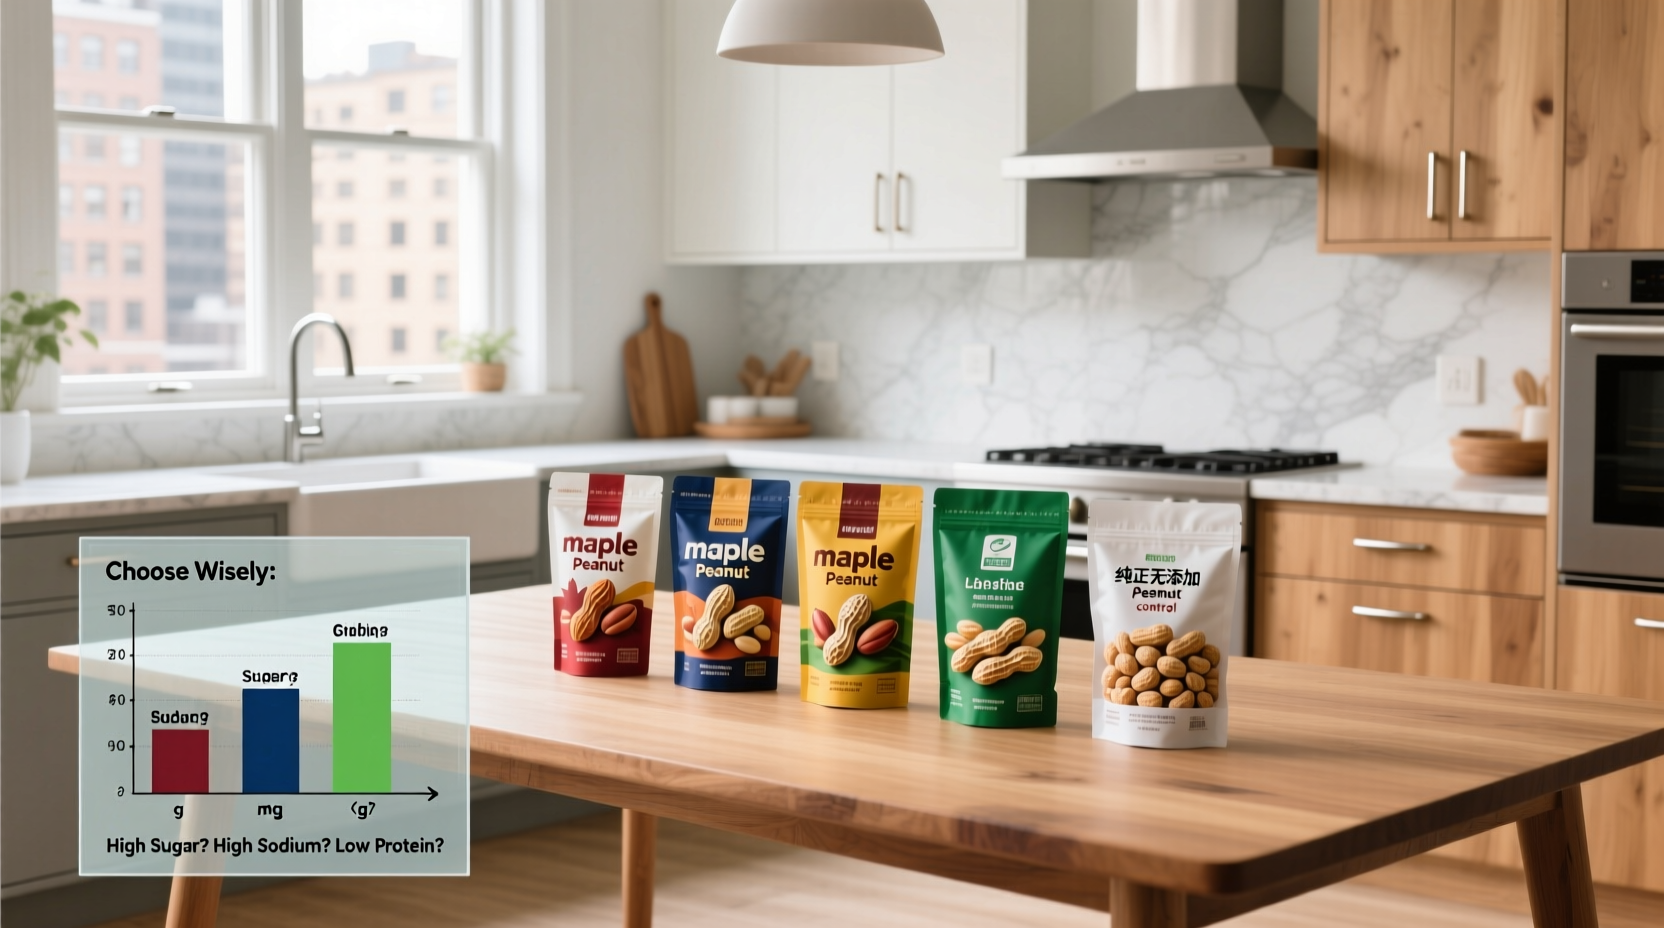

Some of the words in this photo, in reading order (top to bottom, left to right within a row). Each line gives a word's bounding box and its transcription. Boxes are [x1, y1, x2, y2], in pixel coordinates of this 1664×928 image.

[563, 532, 638, 559] maple
[684, 537, 765, 565] maple
[573, 557, 624, 572] Peanut
[814, 545, 894, 573] maple
[695, 563, 750, 579] Peanut
[825, 571, 878, 587] Peanut
[1115, 565, 1201, 586] 纯正无添加
[1136, 602, 1177, 613] control
